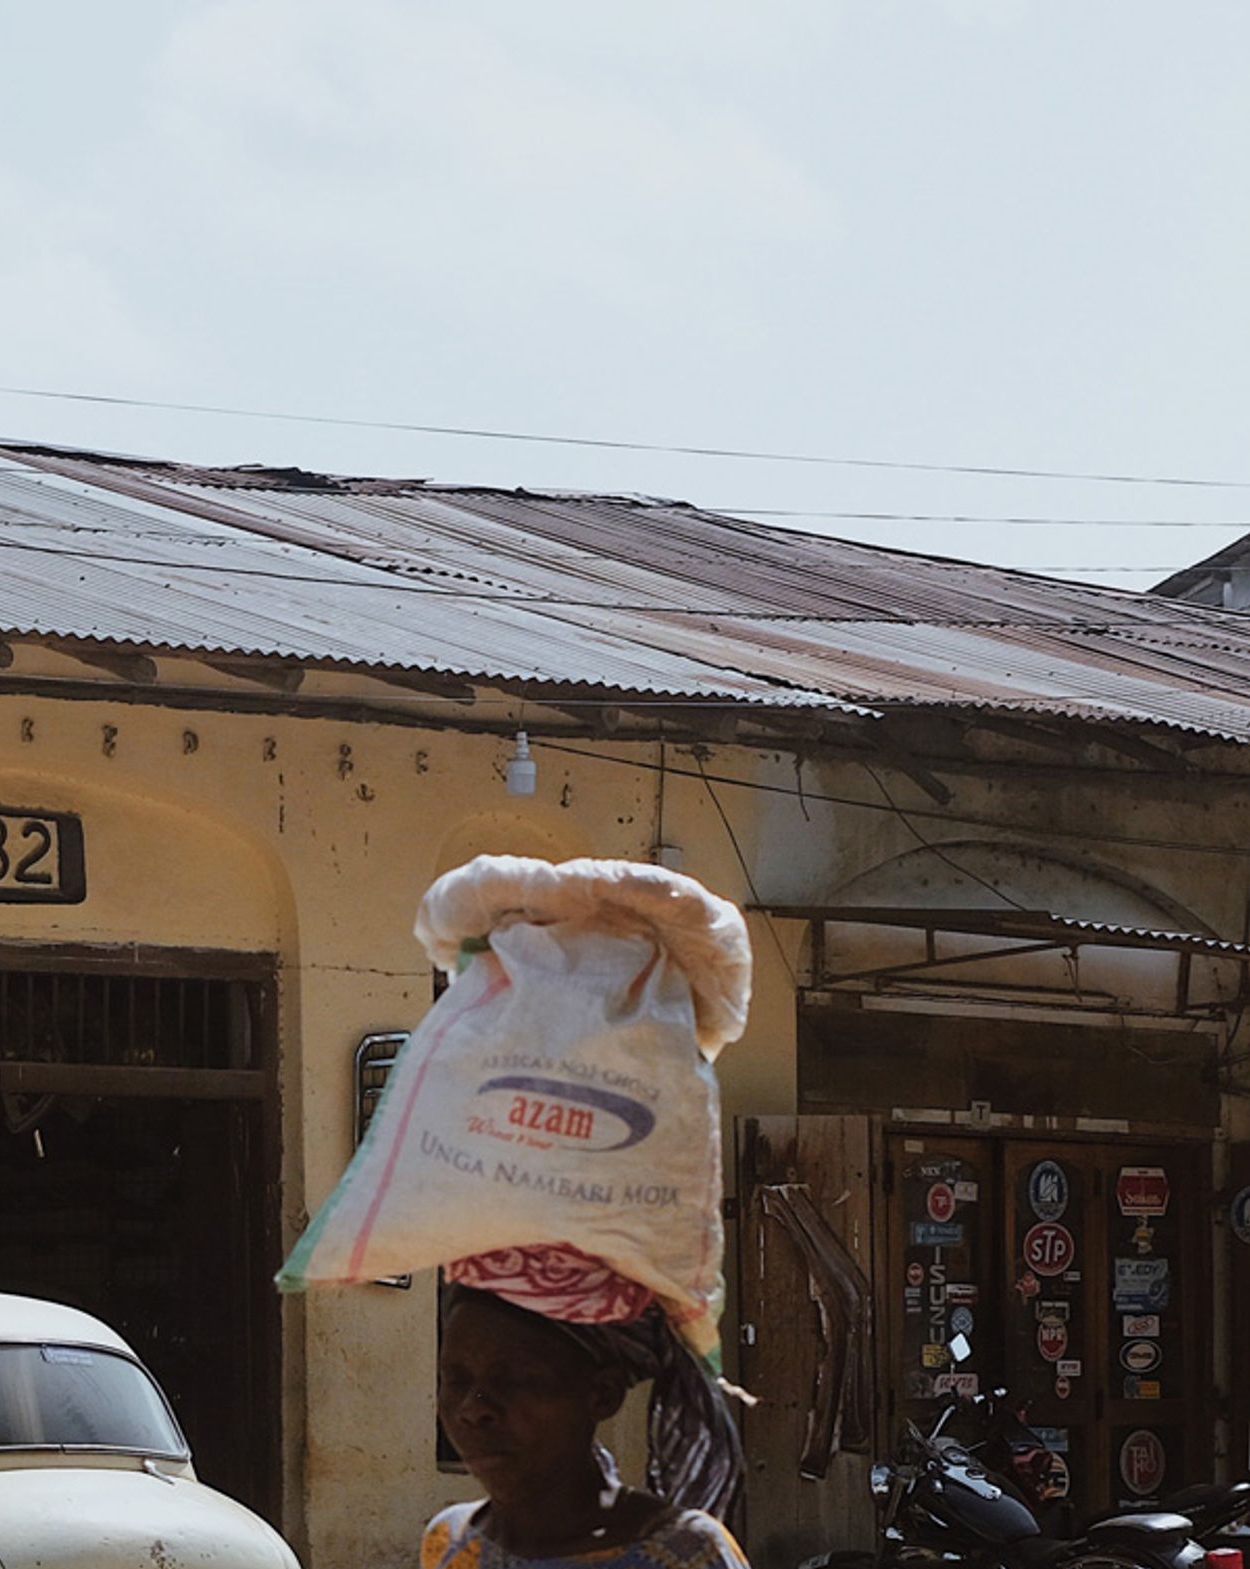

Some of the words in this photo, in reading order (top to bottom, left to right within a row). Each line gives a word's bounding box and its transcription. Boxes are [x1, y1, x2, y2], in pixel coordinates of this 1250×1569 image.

[508, 1095, 595, 1140] azam
[976, 1104, 987, 1120] T
[420, 1130, 485, 1177] UNGA
[494, 1160, 612, 1204] NAMBARI
[1031, 1229, 1066, 1264] STP
[928, 1245, 947, 1345] ISUZU
